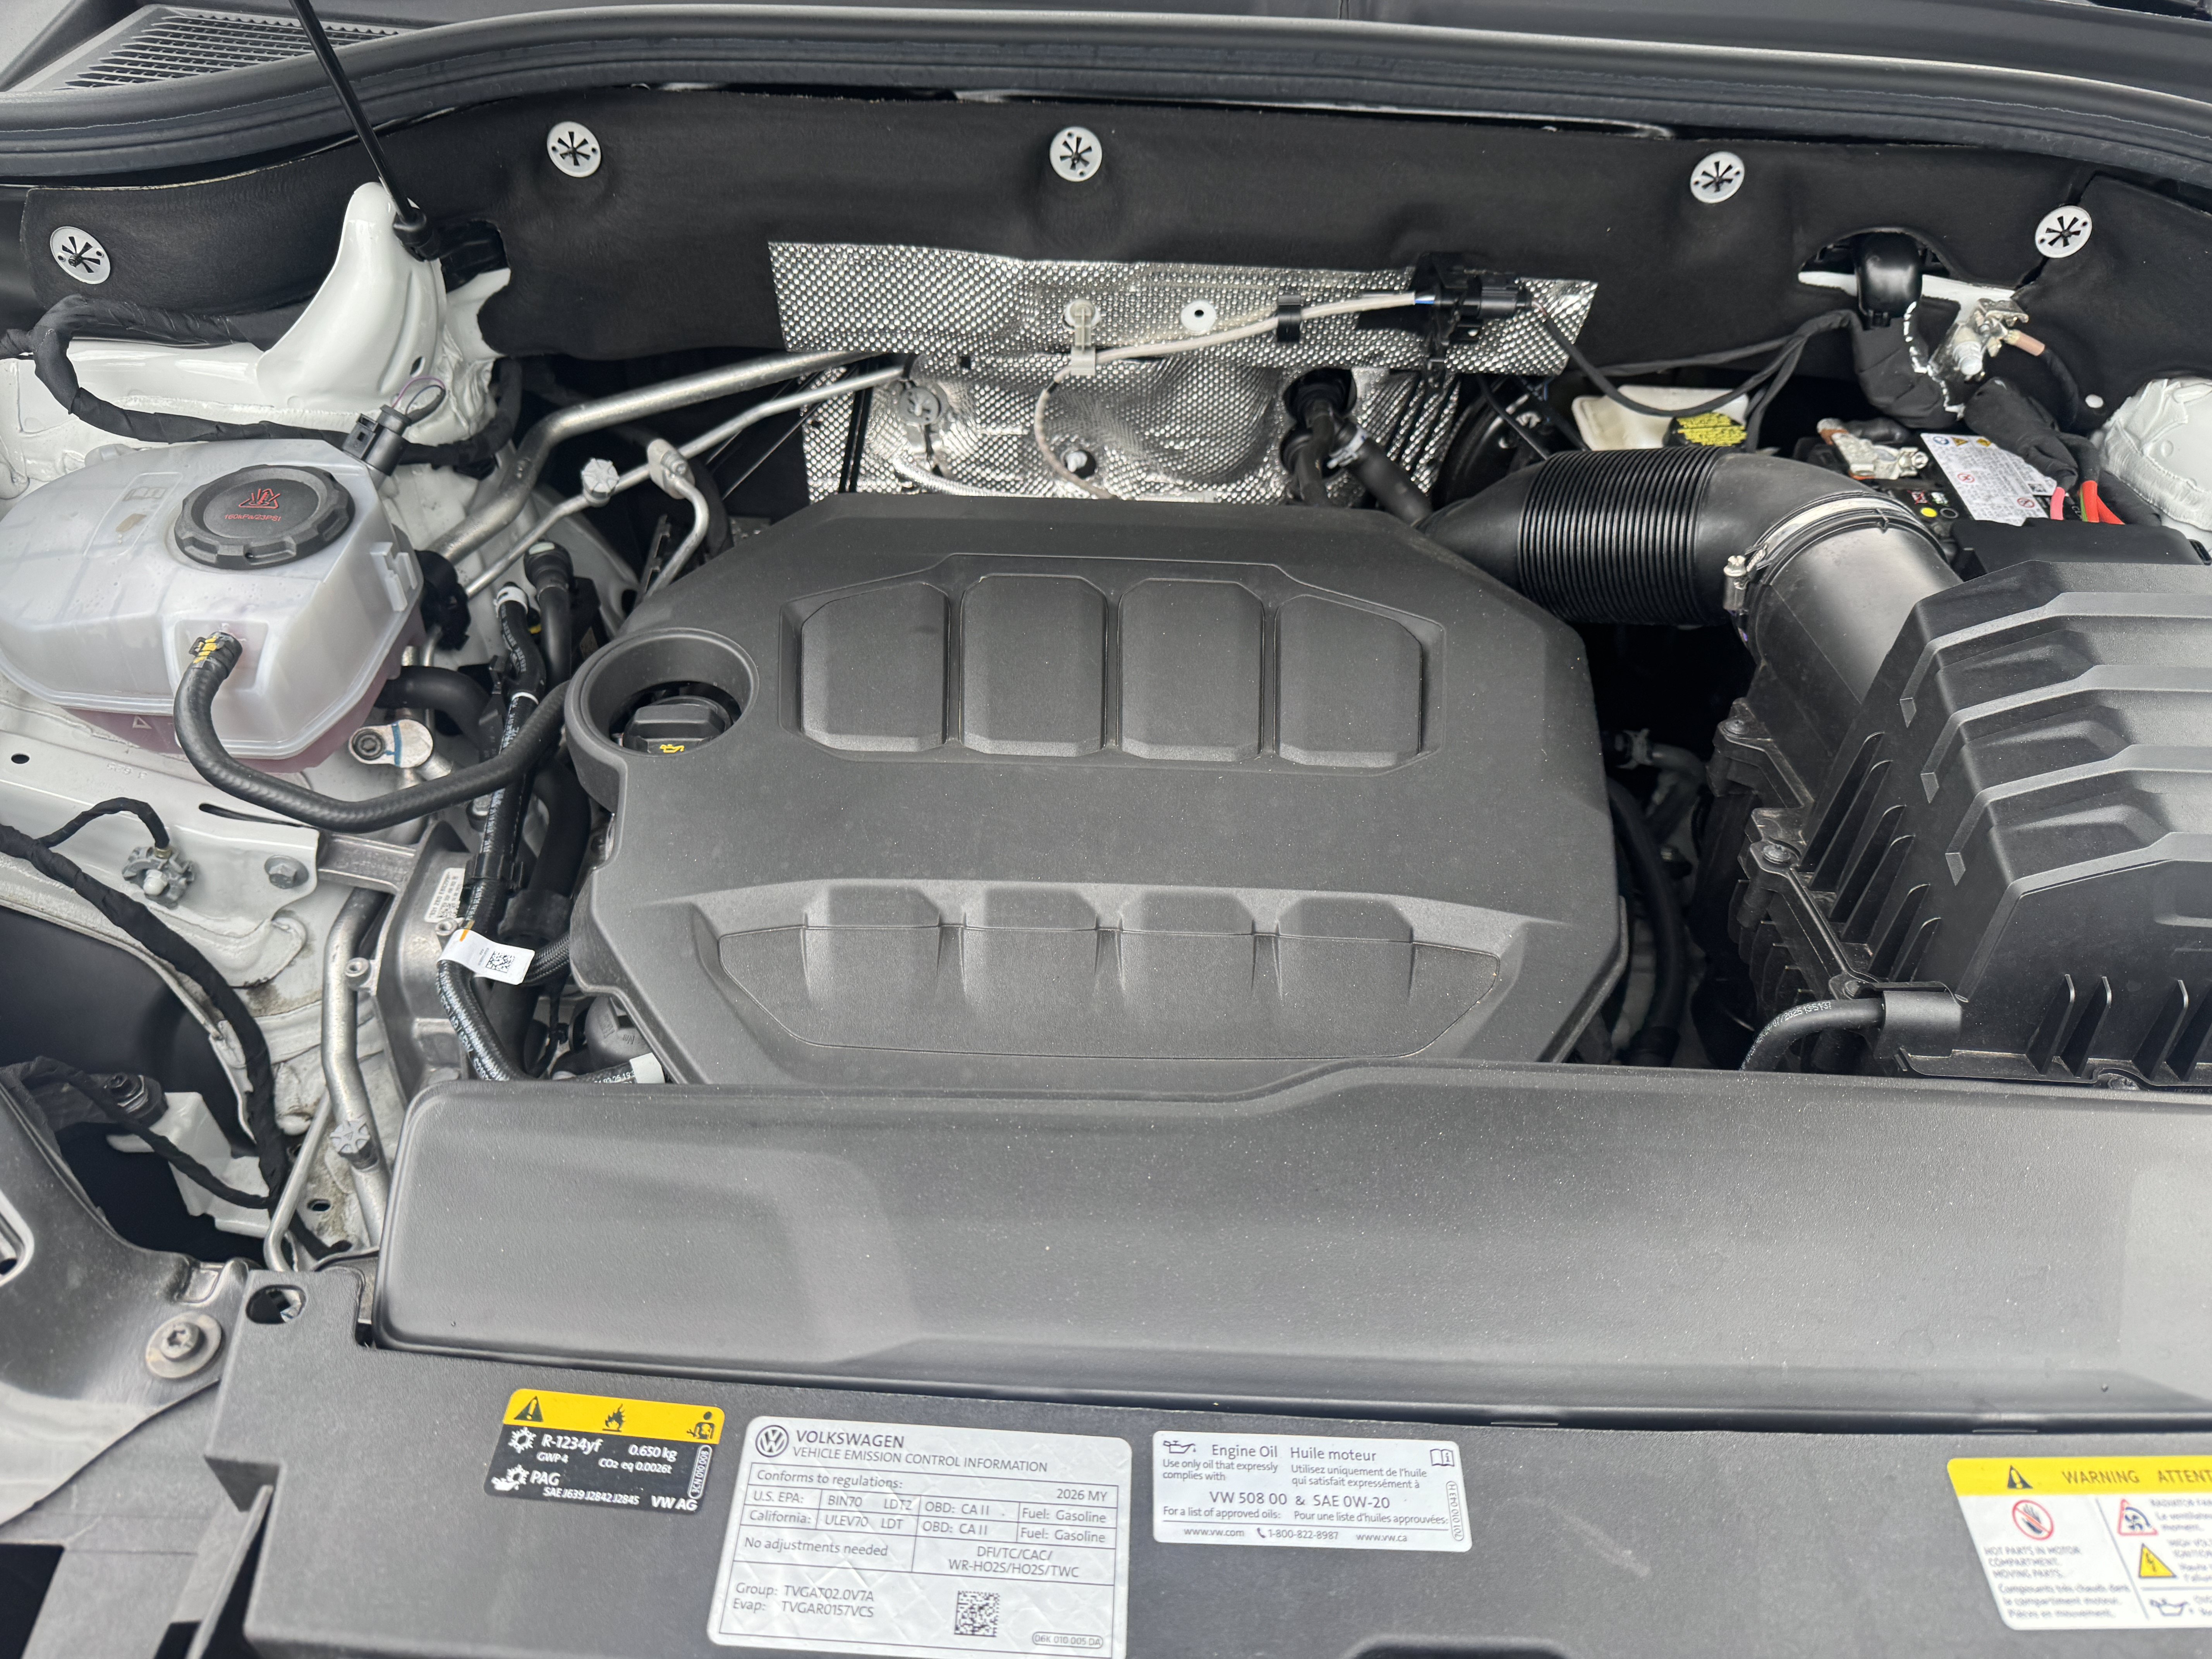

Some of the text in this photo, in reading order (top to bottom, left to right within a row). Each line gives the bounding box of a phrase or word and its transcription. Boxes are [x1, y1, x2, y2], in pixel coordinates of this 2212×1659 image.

[542, 1434, 604, 1455] R-1234yf
[797, 1430, 904, 1448] VOLKSWAGEN
[628, 1444, 678, 1462] 0.650 kg
[793, 1446, 1047, 1472] VEHICLE EMISSION CONTROL INFORMATION
[1212, 1444, 1278, 1460] Engine Oil
[1291, 1447, 1376, 1462] Huile moteur
[621, 1462, 634, 1472] eq
[635, 1461, 672, 1474] 0.0026t
[1163, 1459, 1278, 1473] Use only oil that expressly
[1291, 1465, 1427, 1478] Utilisez uniquement de l'huile
[529, 1470, 561, 1486] PAG
[757, 1470, 902, 1489] Conforms to regulations:
[1163, 1472, 1225, 1481] complies with
[1292, 1477, 1420, 1489] qui satisfait expressément à
[2062, 1470, 2140, 1484] WARNING
[543, 1486, 640, 1505] SAE J639 J2842 J2845
[754, 1491, 804, 1503] U.S. EPA:
[828, 1495, 862, 1507] BIN70
[1056, 1489, 1107, 1501] 2026 MY
[1210, 1491, 1390, 1508] VW 508 00 & SAE 0W-20
[651, 1495, 698, 1511] VW AG
[884, 1499, 912, 1510] LDT2
[925, 1501, 955, 1513] OBD:
[962, 1503, 977, 1515] CA
[750, 1510, 811, 1523] California:
[1022, 1508, 1106, 1523] Fuel: Gasoline
[1163, 1506, 1178, 1515] For
[1188, 1508, 1201, 1516] list
[1205, 1508, 1213, 1517] of
[1216, 1509, 1259, 1519] approved
[1262, 1510, 1281, 1518] oils:
[1295, 1511, 1448, 1525] Pour une liste d'huiles approuvées:
[1451, 1509, 1460, 1523] 010
[825, 1515, 868, 1527] ULEV70
[881, 1518, 904, 1529] LDT
[923, 1521, 952, 1533] OBD:
[960, 1523, 975, 1535] CA
[1020, 1527, 1105, 1543] Fuel: Gasoline
[1184, 1528, 1244, 1537] www.vw.com
[1268, 1529, 1338, 1540] 1-800-822-8987
[1356, 1533, 1407, 1542] www.vw.ca
[745, 1537, 888, 1556] No adjustments needed
[977, 1546, 1053, 1561] DFI/TC/CAC/
[2005, 1546, 2034, 1555] PARTS
[949, 1559, 1079, 1577] WR-HO2S/HO2S/TWC
[736, 1582, 778, 1598] Group:
[733, 1598, 874, 1618] Evap: TVGAR0157VCS
